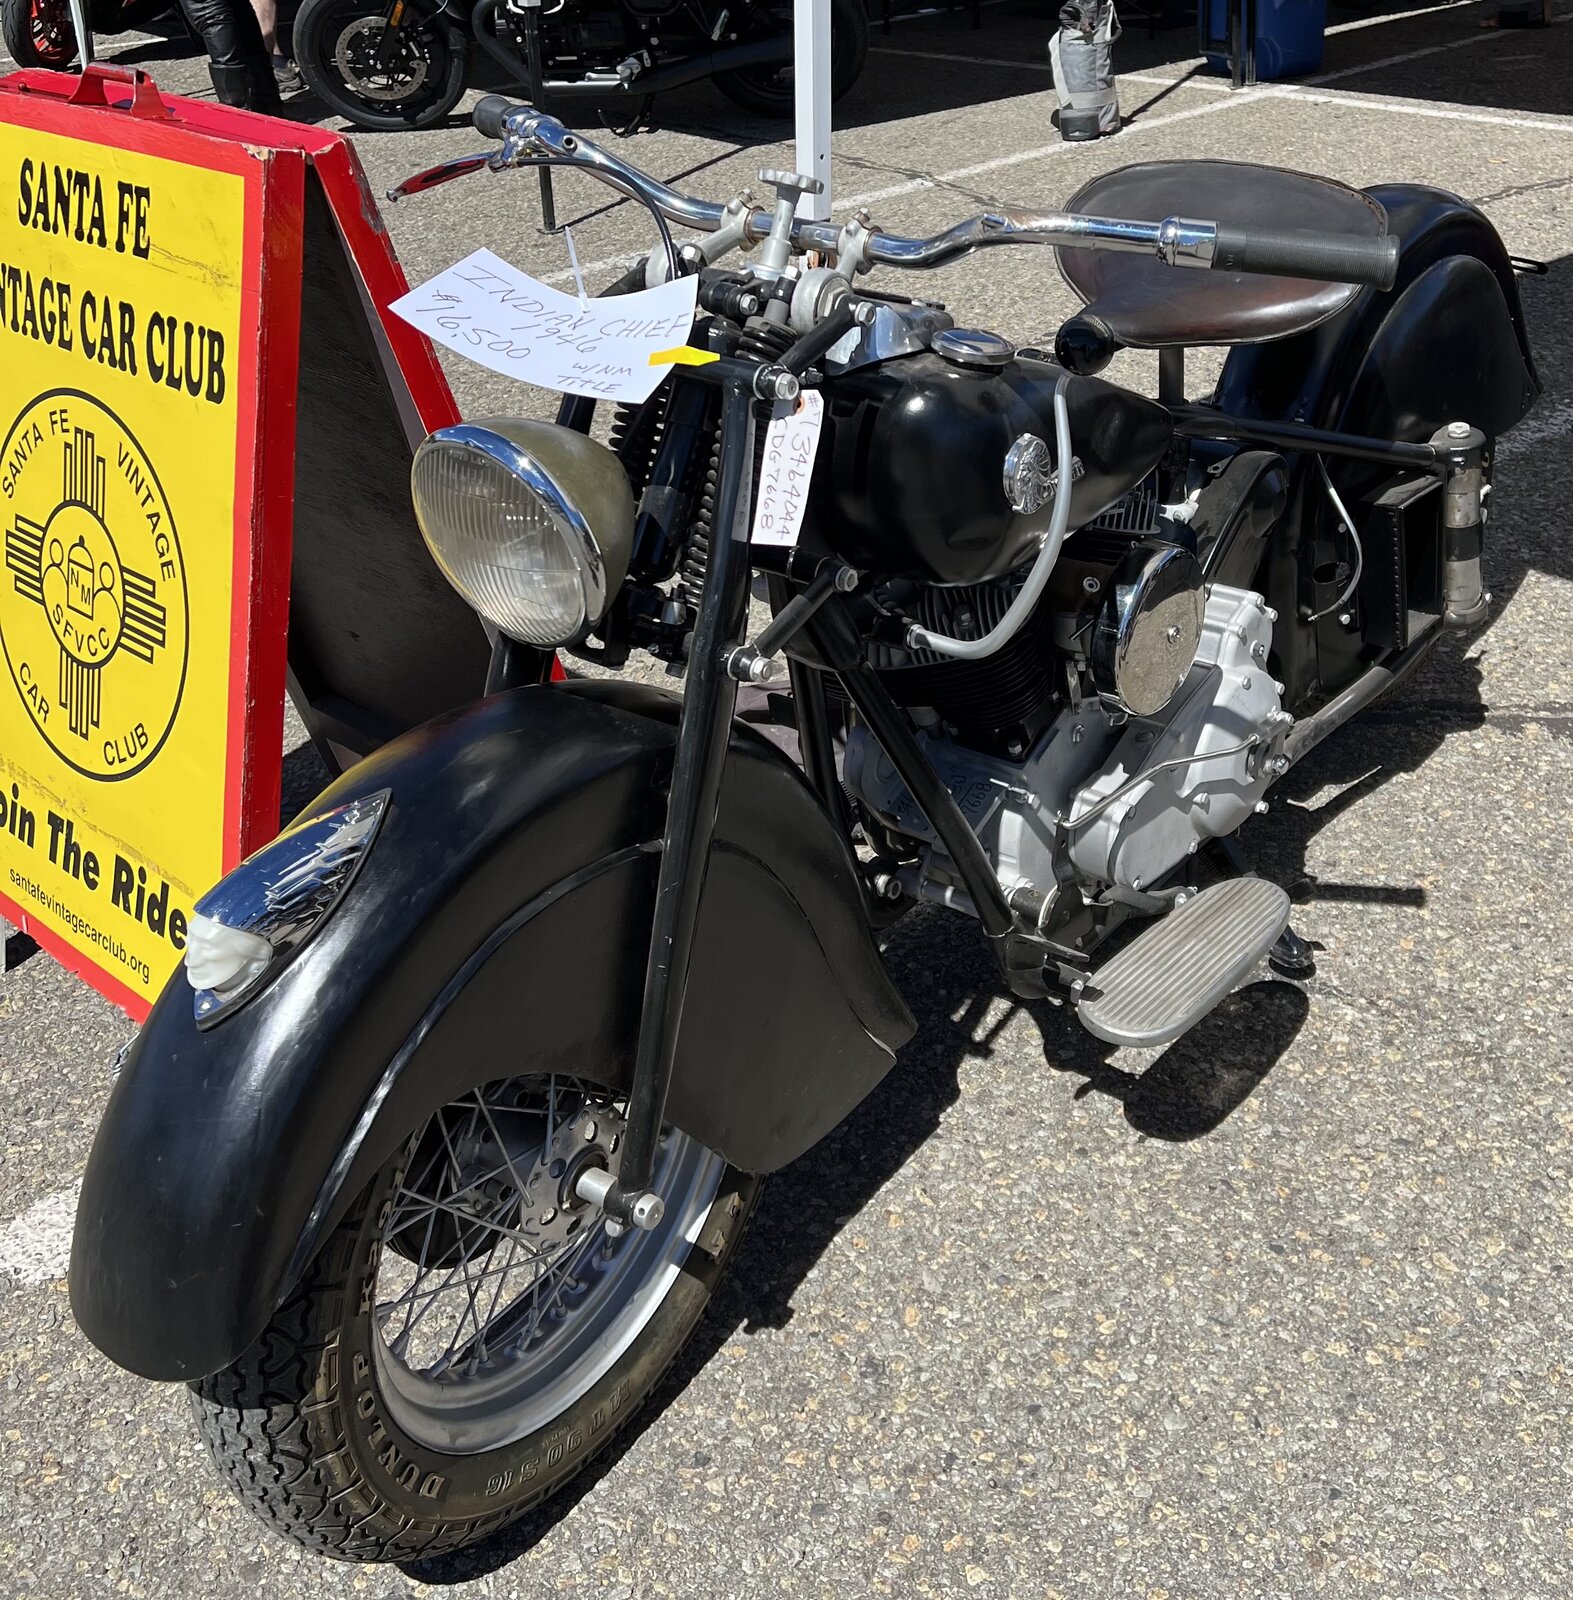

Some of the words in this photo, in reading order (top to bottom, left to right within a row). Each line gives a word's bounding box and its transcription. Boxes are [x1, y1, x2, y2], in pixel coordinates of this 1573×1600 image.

[18, 157, 107, 248] SANTA
[115, 180, 150, 260] FE
[80, 290, 137, 376] CAR
[146, 311, 225, 404] CLUB
[452, 265, 595, 331] INDIAN
[600, 313, 690, 338] CHIEF
[511, 324, 603, 353] 1946
[2, 422, 44, 500] SANTA
[49, 409, 70, 436] FE
[117, 441, 176, 582] VINTAGE
[52, 603, 110, 657] SFVCC
[19, 662, 50, 724] CAR
[103, 722, 149, 766] CLUB
[9, 868, 150, 985] santafevintagecarclub.org
[48, 809, 100, 891] The
[111, 853, 188, 950] Ride
[353, 1353, 445, 1500] DUNLOP
